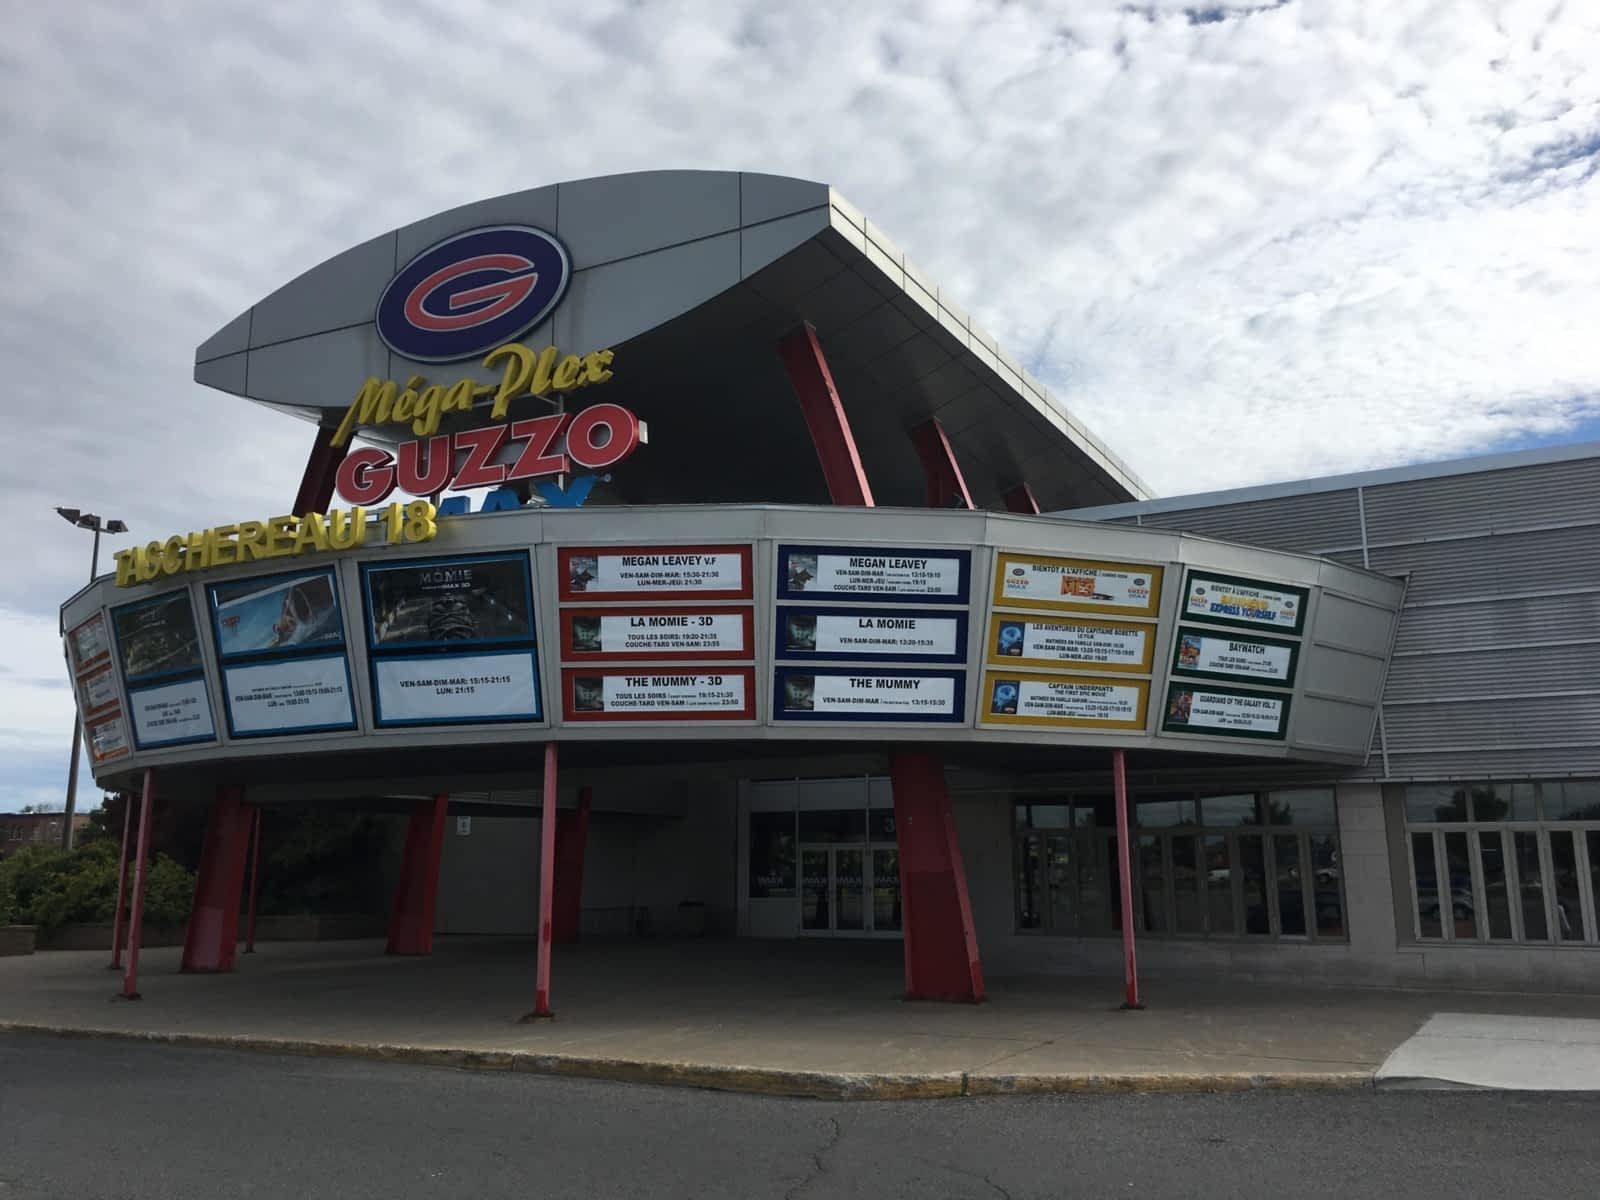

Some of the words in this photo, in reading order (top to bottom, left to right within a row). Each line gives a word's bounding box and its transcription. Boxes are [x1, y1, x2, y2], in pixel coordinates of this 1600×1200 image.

[404, 254, 538, 331] G
[330, 343, 614, 447] Méga-Plex
[335, 403, 640, 505] GUZZO
[114, 505, 365, 588] TASCHEREAU
[381, 499, 437, 546] 18
[622, 556, 659, 566] MEGAN
[662, 556, 702, 566] LEAVEY
[704, 557, 716, 566] V.F
[850, 558, 886, 568] MEGAN
[888, 558, 928, 570] LEAVEY
[419, 569, 472, 585] MOMIE
[630, 617, 646, 627] LA
[648, 616, 688, 626] MOMIE
[698, 616, 713, 626] 3D
[858, 619, 874, 628] LA
[876, 619, 916, 630] MOMIE
[1228, 642, 1265, 654] BAYWATCH
[625, 677, 648, 687] THE
[652, 676, 697, 687] MUMMY
[707, 676, 723, 686] 3D
[849, 678, 872, 688] THE
[876, 679, 920, 689] MUMMY
[436, 686, 454, 695] LUN:
